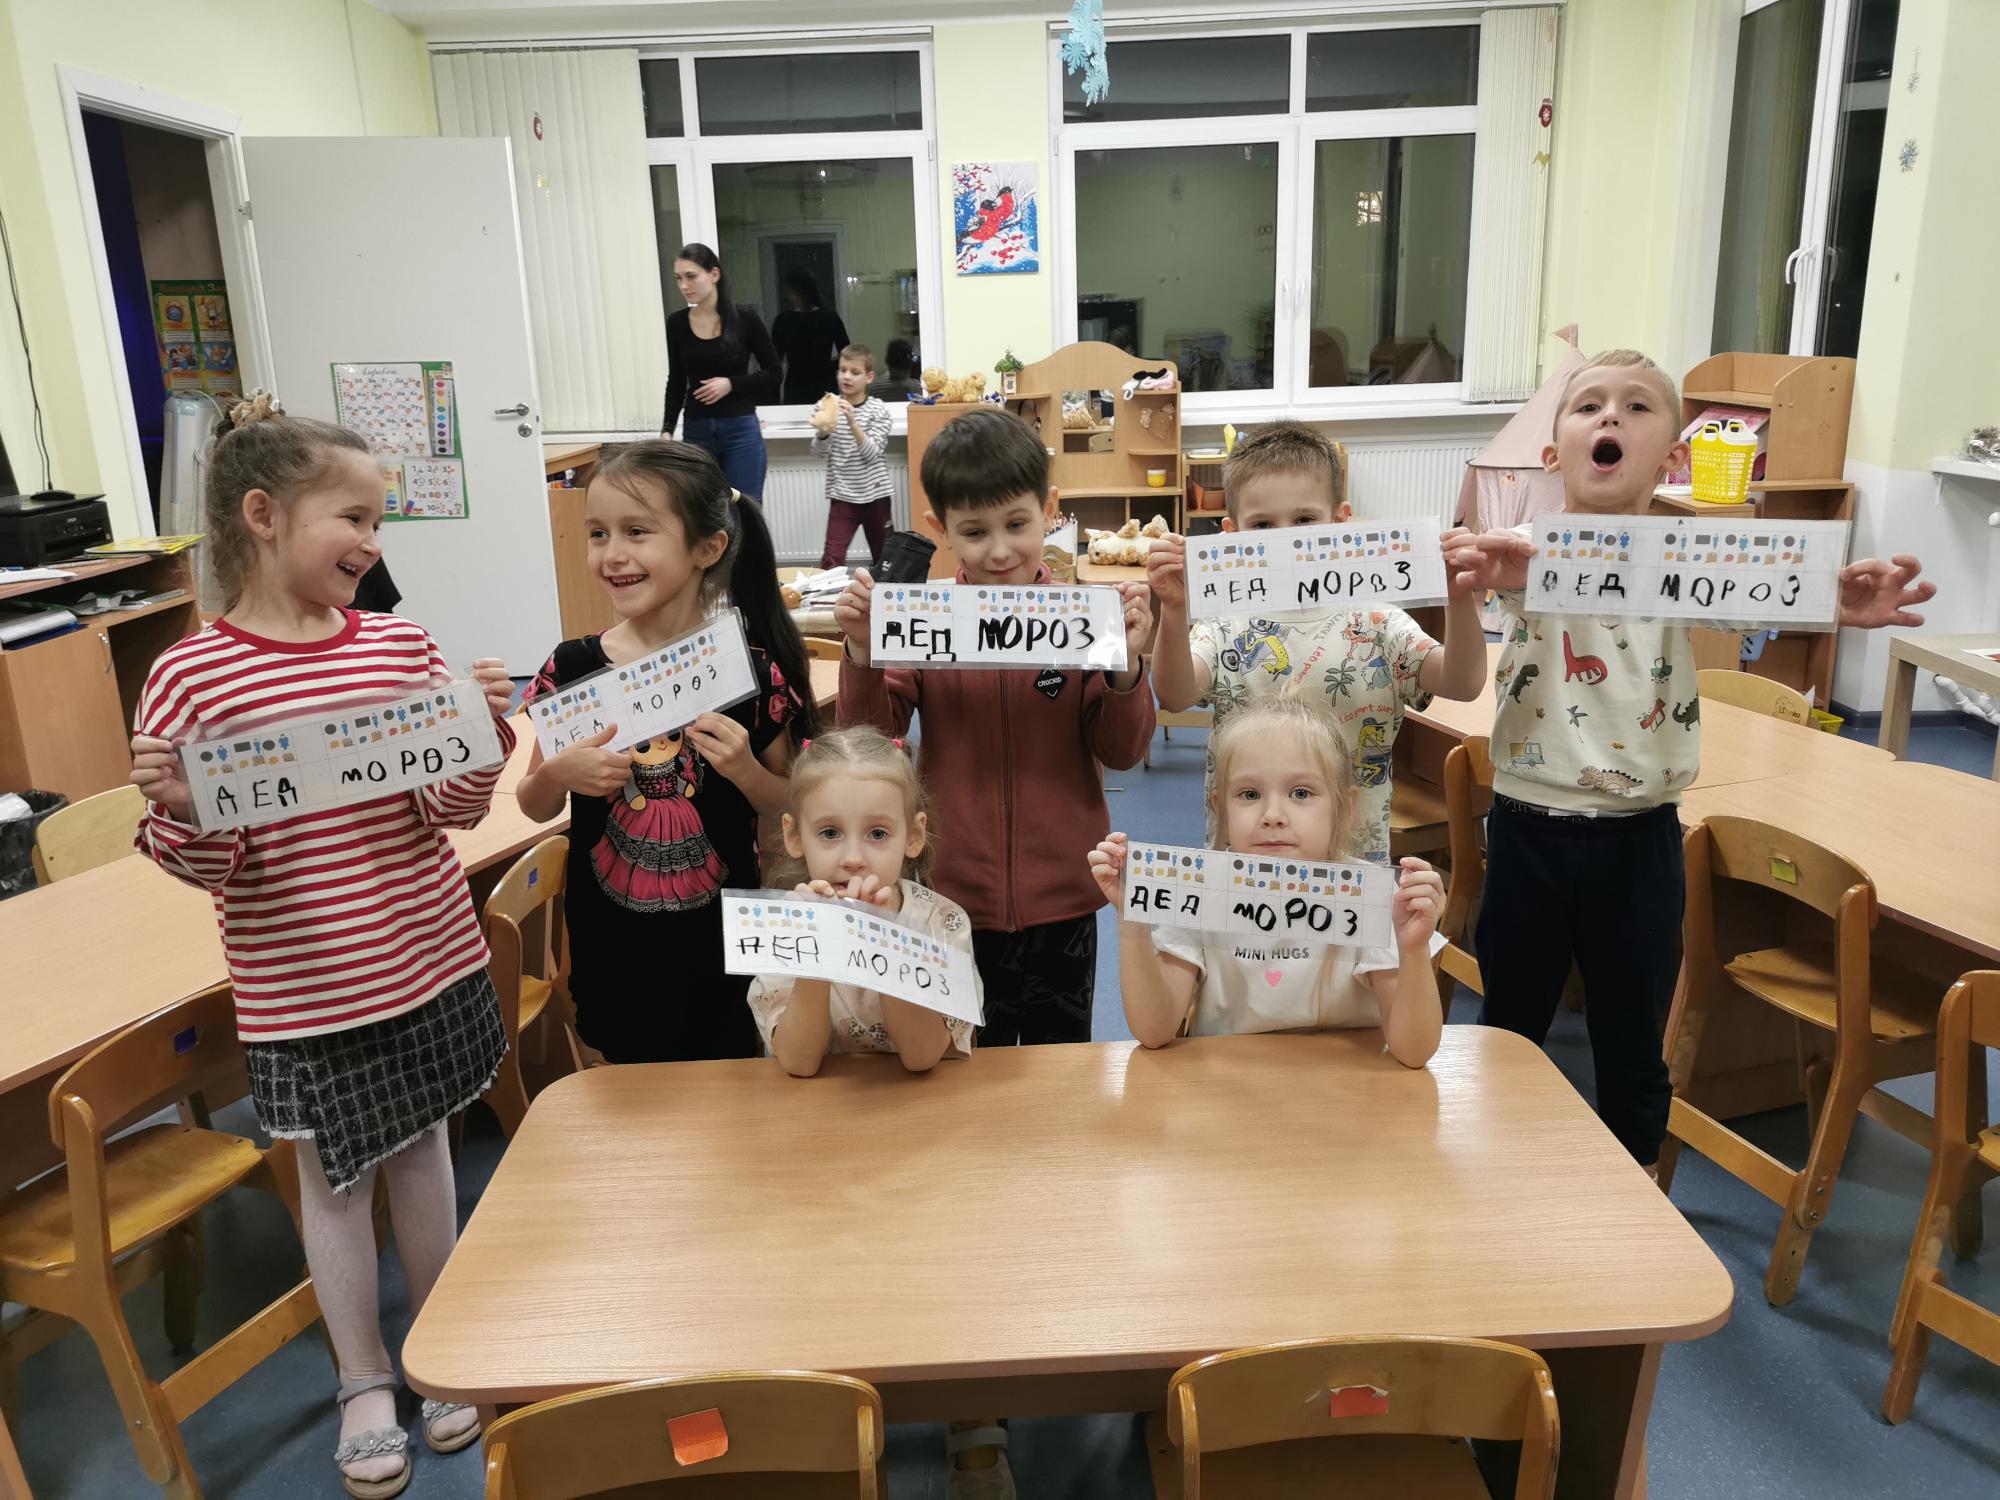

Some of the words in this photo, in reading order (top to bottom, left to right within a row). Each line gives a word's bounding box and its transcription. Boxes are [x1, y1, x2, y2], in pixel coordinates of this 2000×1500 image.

[1660, 573, 1800, 607] МОРОЗ
[978, 615, 1095, 652] МОРОЗ
[632, 664, 717, 715] МОРОЗ
[1130, 885, 1200, 916] ДЕД
[1233, 897, 1358, 936] МОРОЗ
[847, 949, 950, 996] МОРОЗ
[1235, 946, 1266, 960] MINI
[1271, 947, 1309, 959] HUGS
